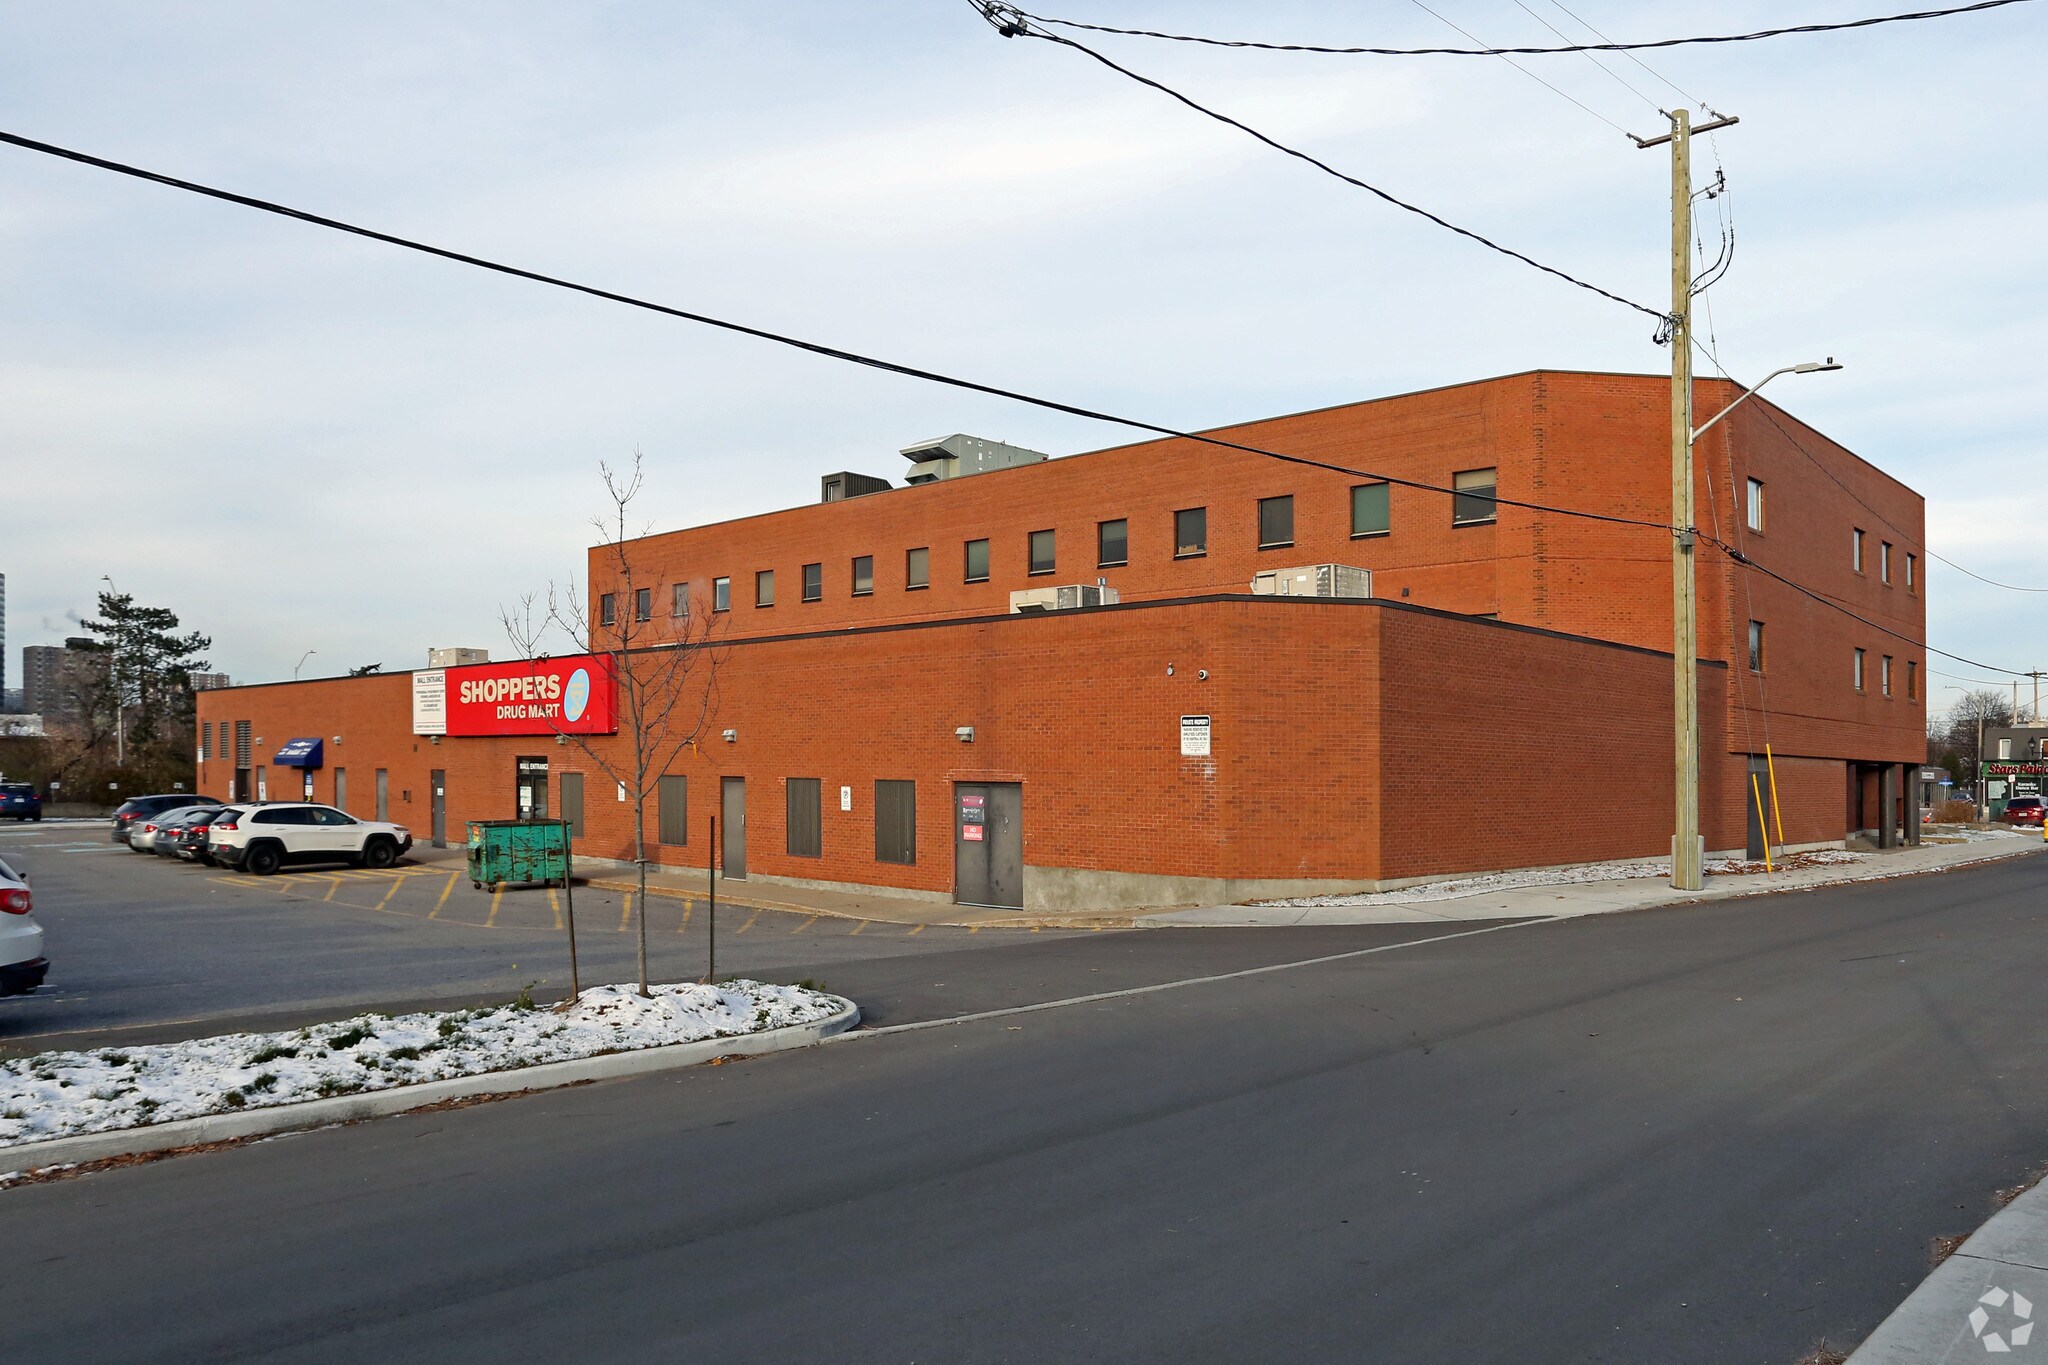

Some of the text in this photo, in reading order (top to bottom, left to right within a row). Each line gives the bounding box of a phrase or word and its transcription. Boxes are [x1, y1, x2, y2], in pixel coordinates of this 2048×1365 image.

[460, 674, 561, 704] SHOPPERS
[497, 703, 560, 720] DRUG MART
